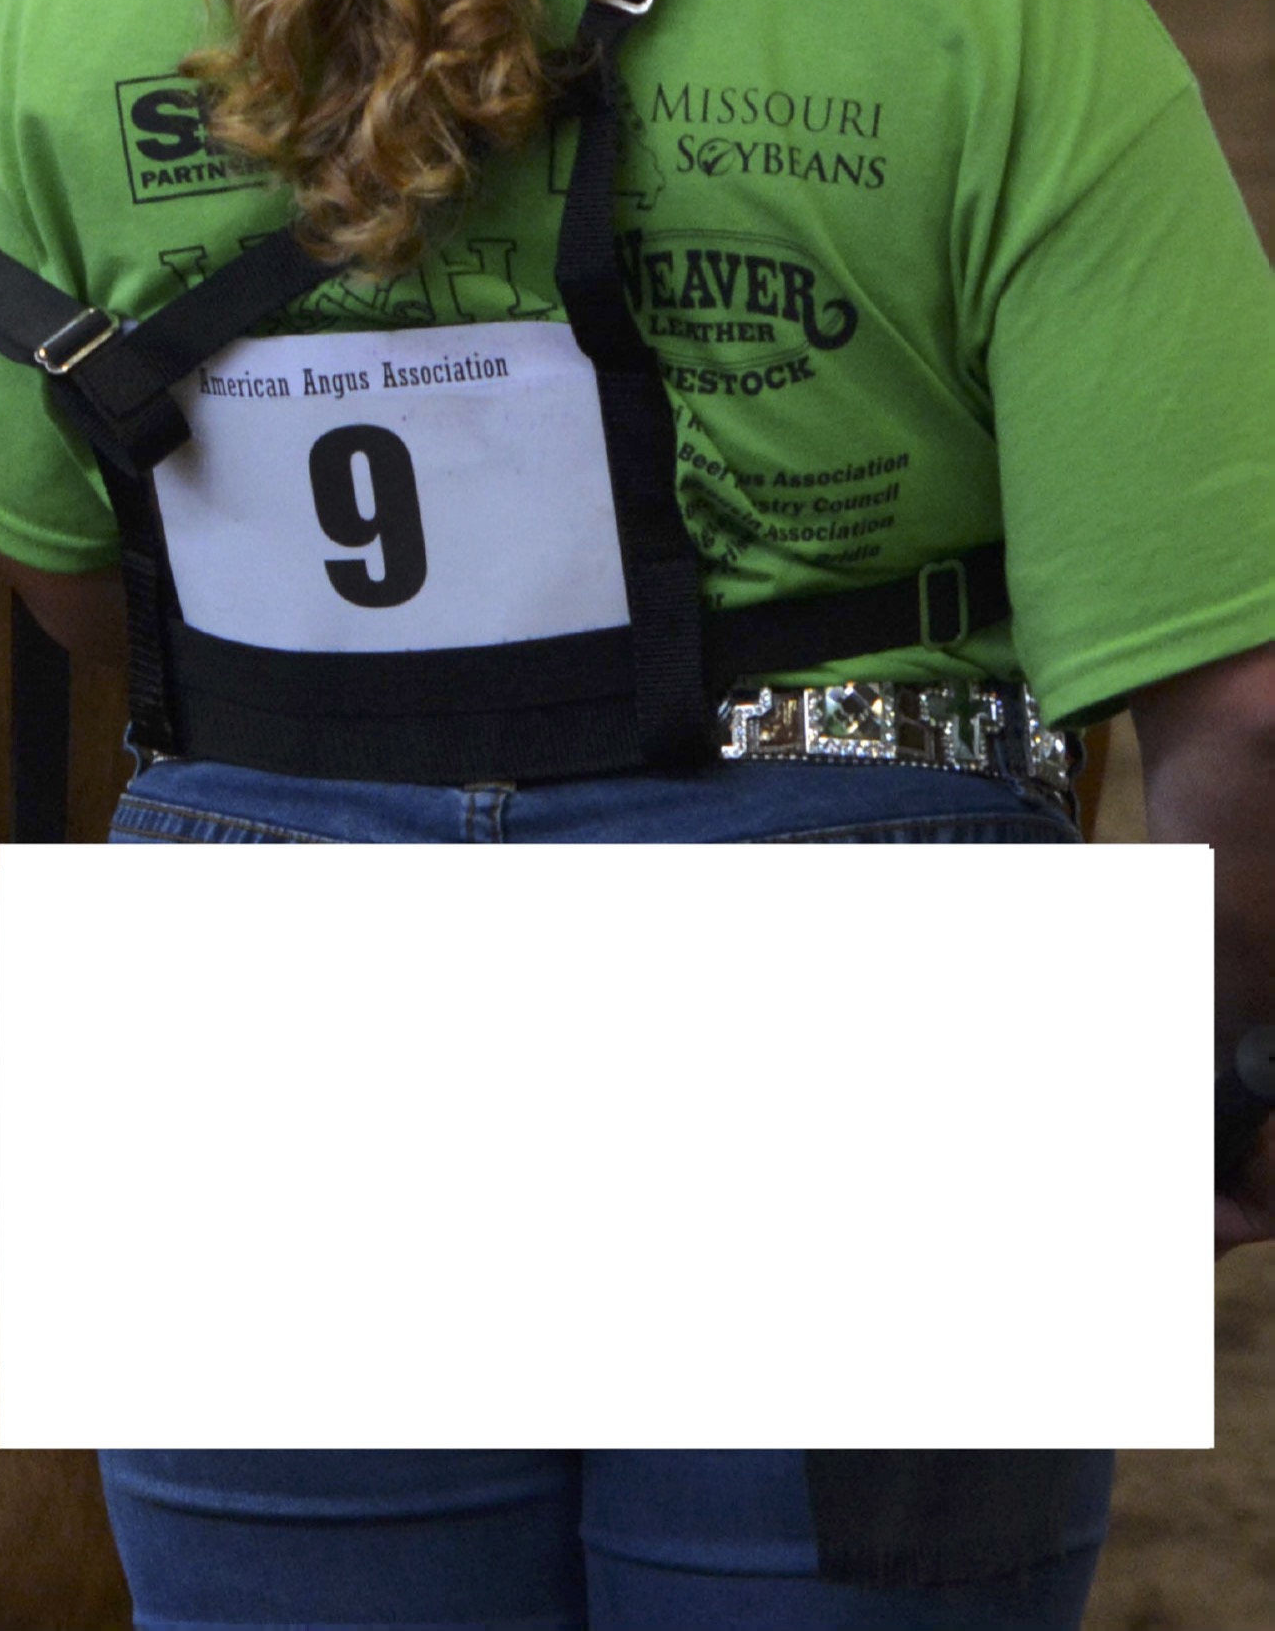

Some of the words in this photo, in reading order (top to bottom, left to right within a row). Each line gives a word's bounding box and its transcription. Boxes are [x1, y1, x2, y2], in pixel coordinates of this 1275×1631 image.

[650, 82, 884, 139] MISSOURI
[676, 134, 887, 190] SOYBEANS
[649, 315, 776, 343] LEATHER
[199, 366, 291, 398] American
[302, 367, 370, 400] Angus
[381, 352, 510, 389] Association
[773, 452, 910, 488] Association
[309, 424, 428, 608] 9
[812, 482, 900, 513] Council
[765, 515, 896, 543] Association
